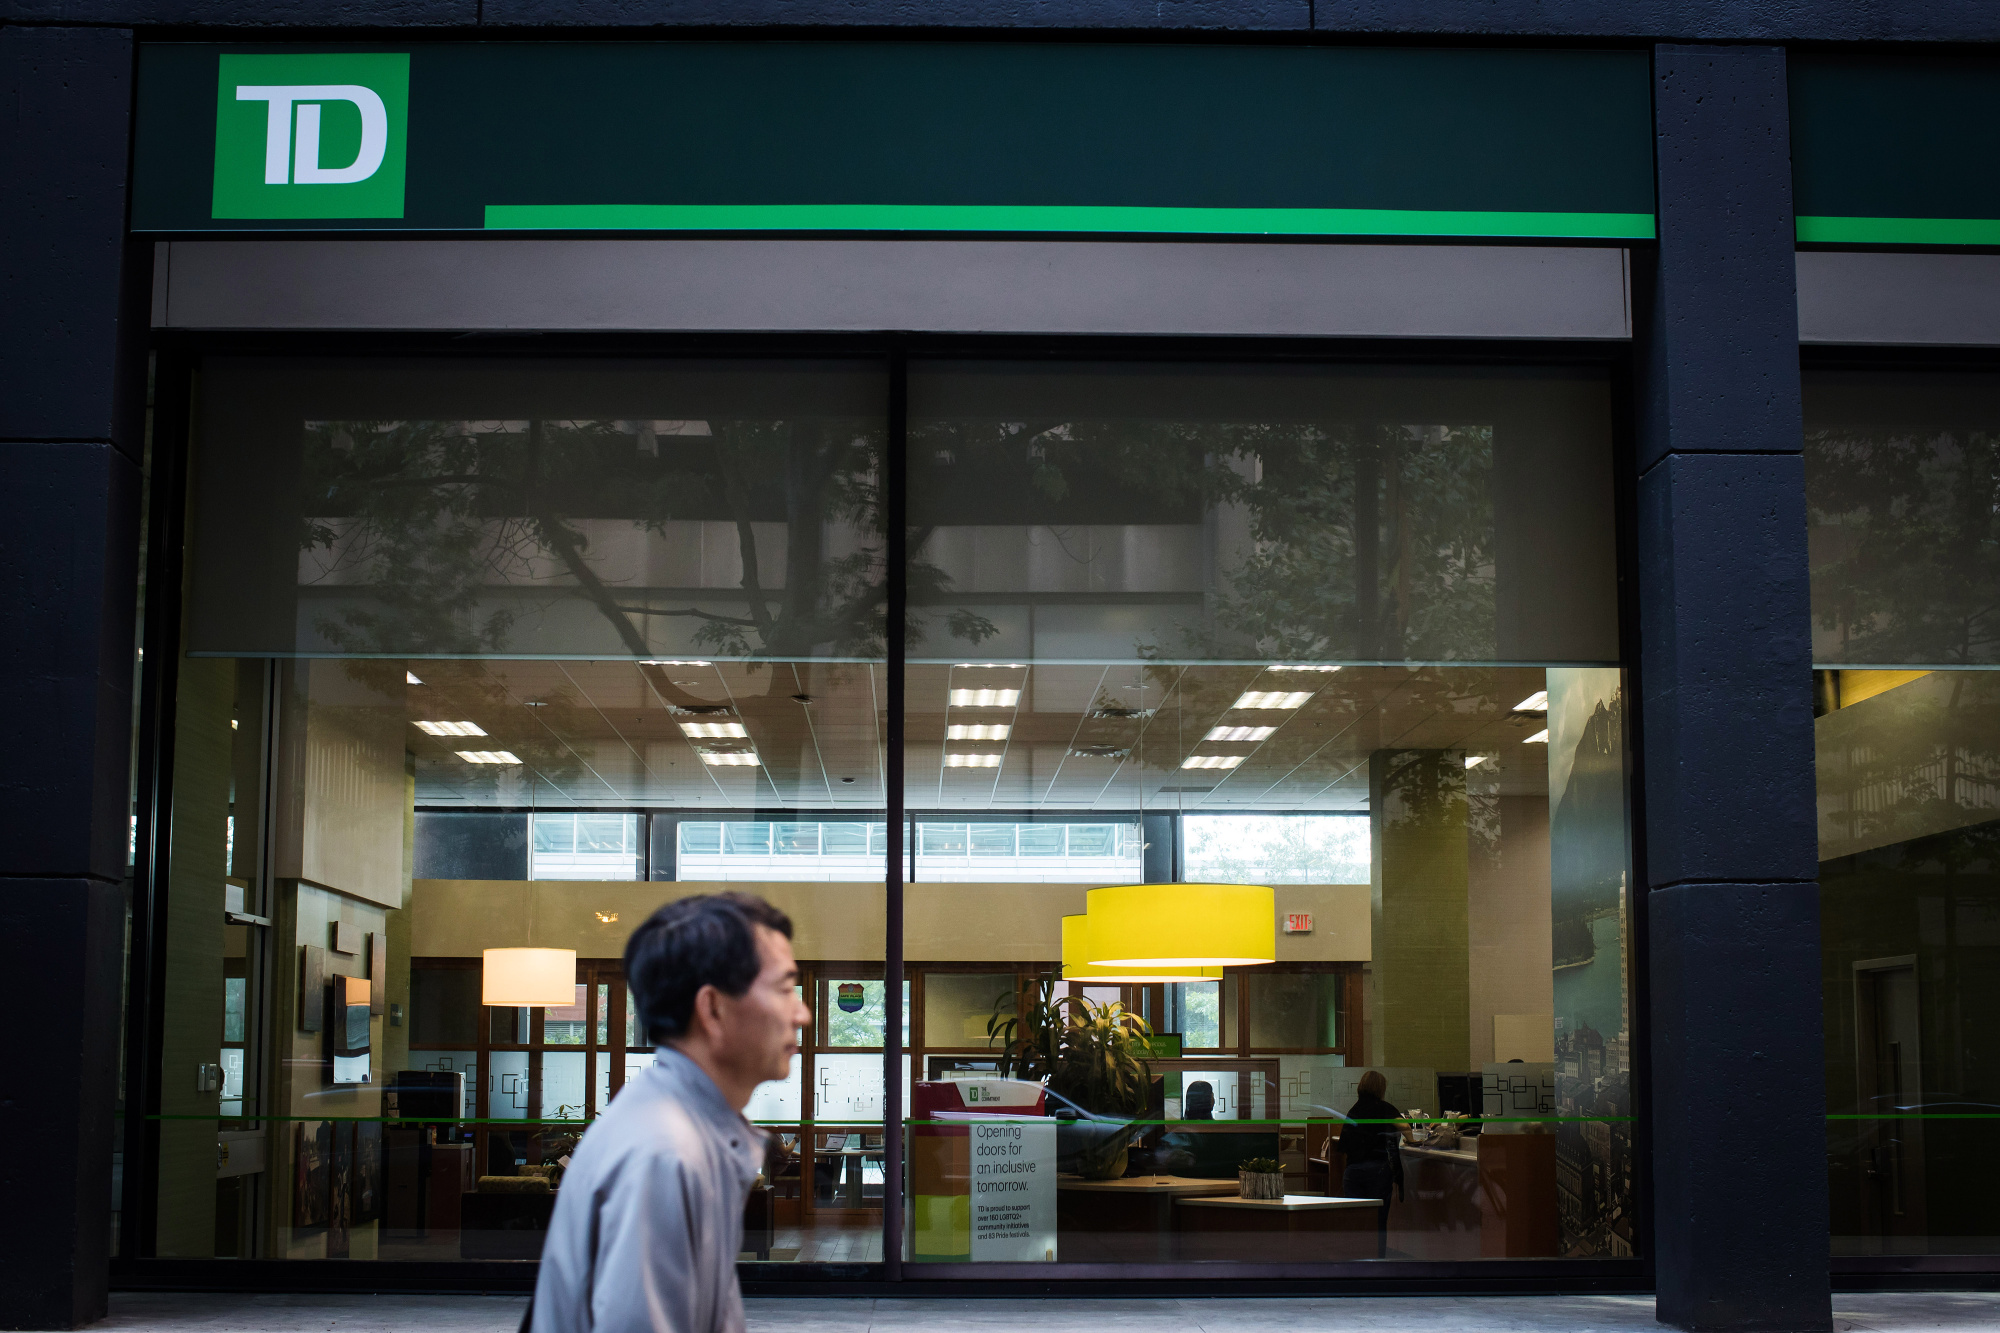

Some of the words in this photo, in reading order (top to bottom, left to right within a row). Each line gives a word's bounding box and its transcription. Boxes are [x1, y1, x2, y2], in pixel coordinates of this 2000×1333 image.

[236, 84, 388, 185] TD
[1289, 914, 1309, 930] EXIT
[976, 1124, 1022, 1140] Opening
[976, 1142, 1007, 1156] doors
[1009, 1142, 1023, 1155] for
[976, 1164, 991, 1174] an
[993, 1160, 1036, 1174] inclusive
[976, 1180, 1029, 1193] tomorrow.
[990, 1205, 1005, 1213] proud
